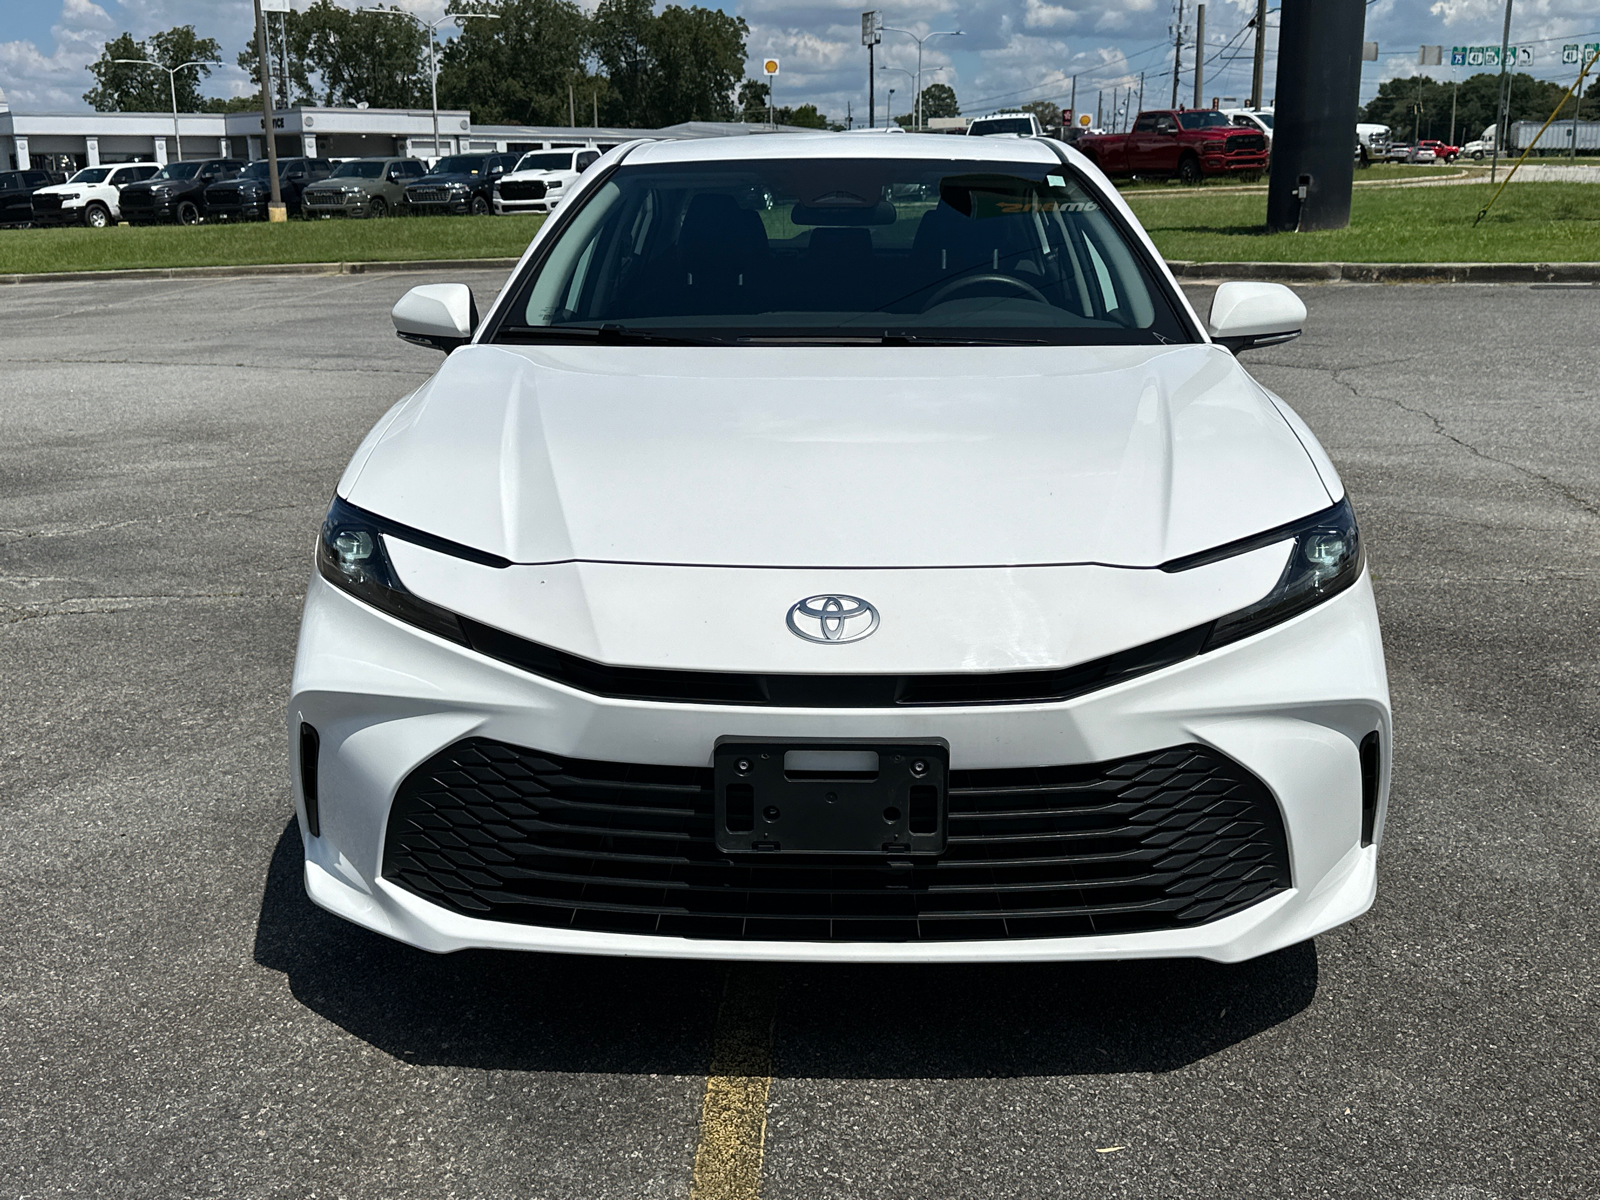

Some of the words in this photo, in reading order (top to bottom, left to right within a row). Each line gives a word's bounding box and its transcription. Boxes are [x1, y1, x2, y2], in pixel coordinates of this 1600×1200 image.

[1455, 54, 1462, 63] 75
[1472, 54, 1479, 63] 41
[1566, 52, 1573, 60] 41
[260, 118, 284, 130] SVICE
